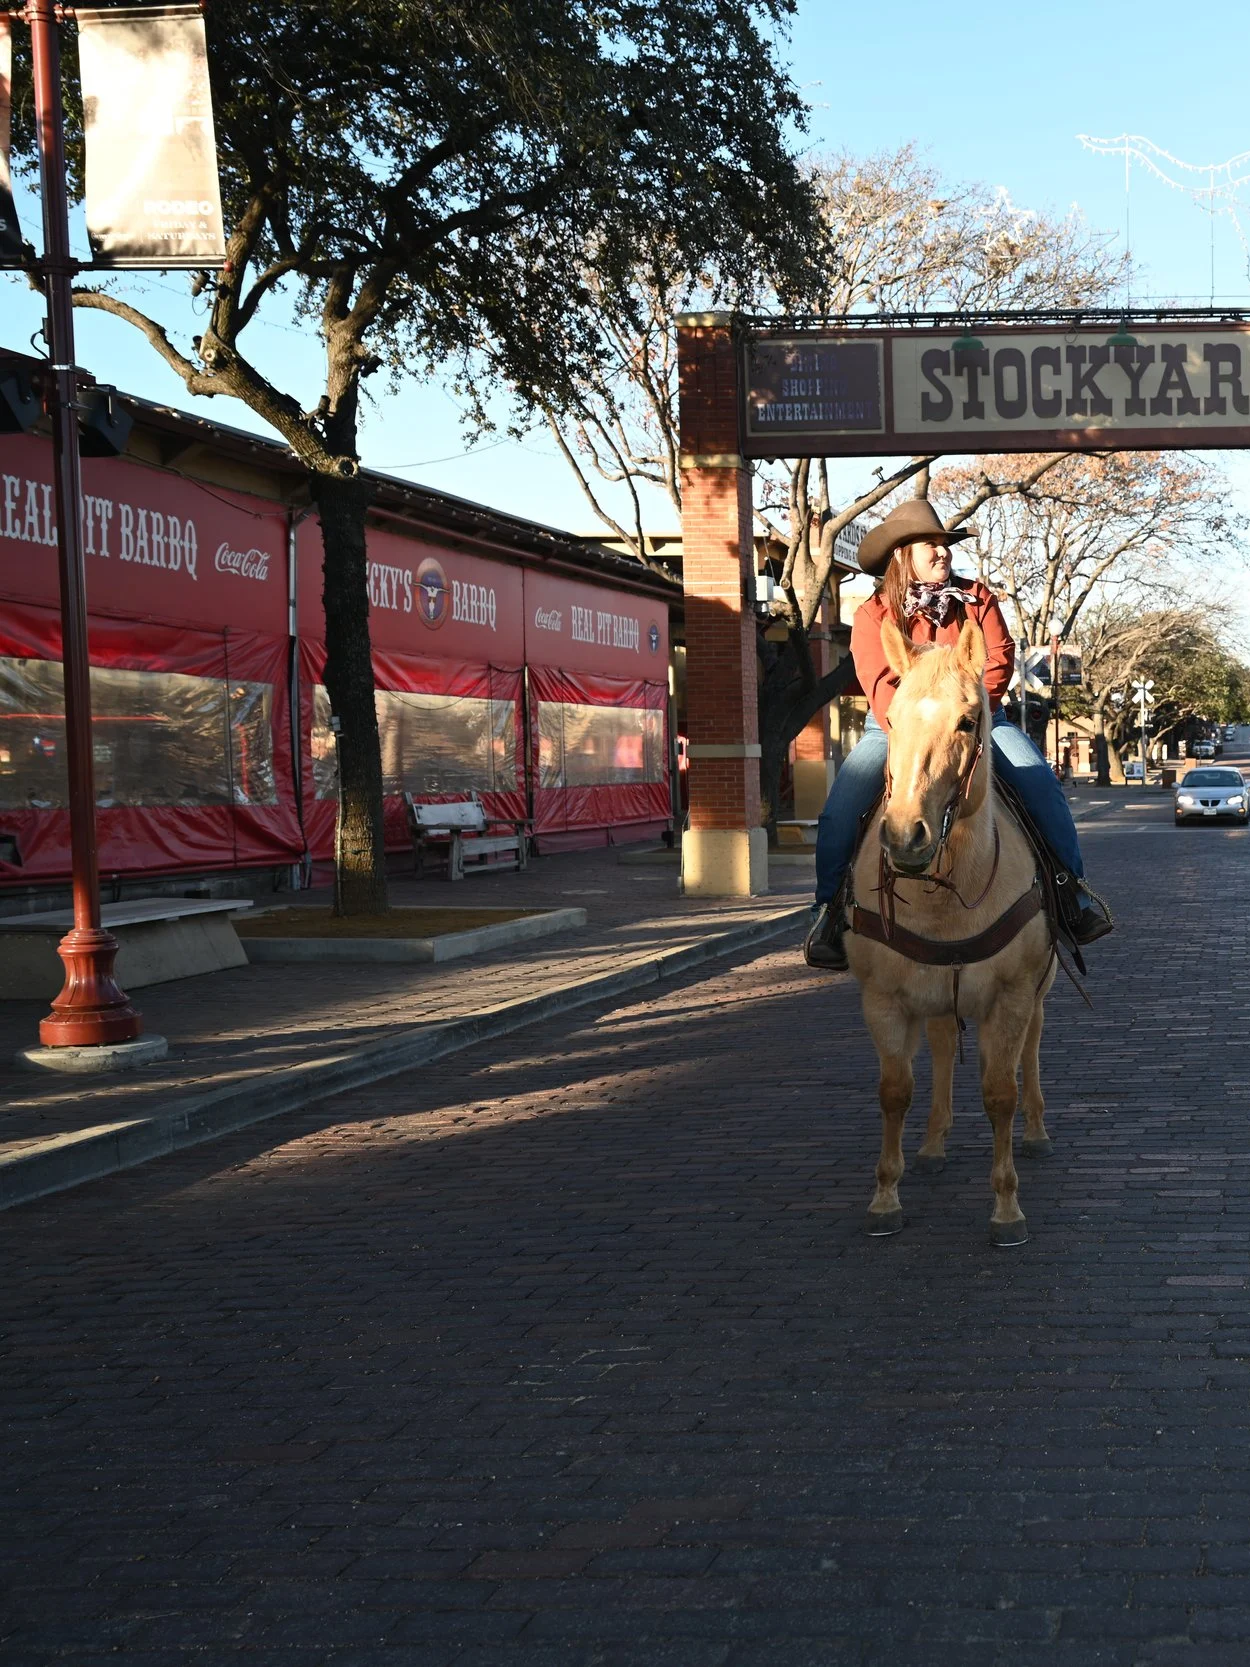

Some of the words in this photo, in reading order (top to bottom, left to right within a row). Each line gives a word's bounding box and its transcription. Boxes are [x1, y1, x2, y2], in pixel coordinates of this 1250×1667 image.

[144, 200, 214, 215] RODEO
[757, 402, 872, 422] ENTERTAINMENT
[0, 474, 58, 547] EAL
[80, 494, 113, 557] IT
[215, 542, 271, 581] Coca-Cola
[535, 607, 562, 632] Coca-Cola
[571, 605, 595, 643] REAL
[597, 611, 612, 646] PIT
